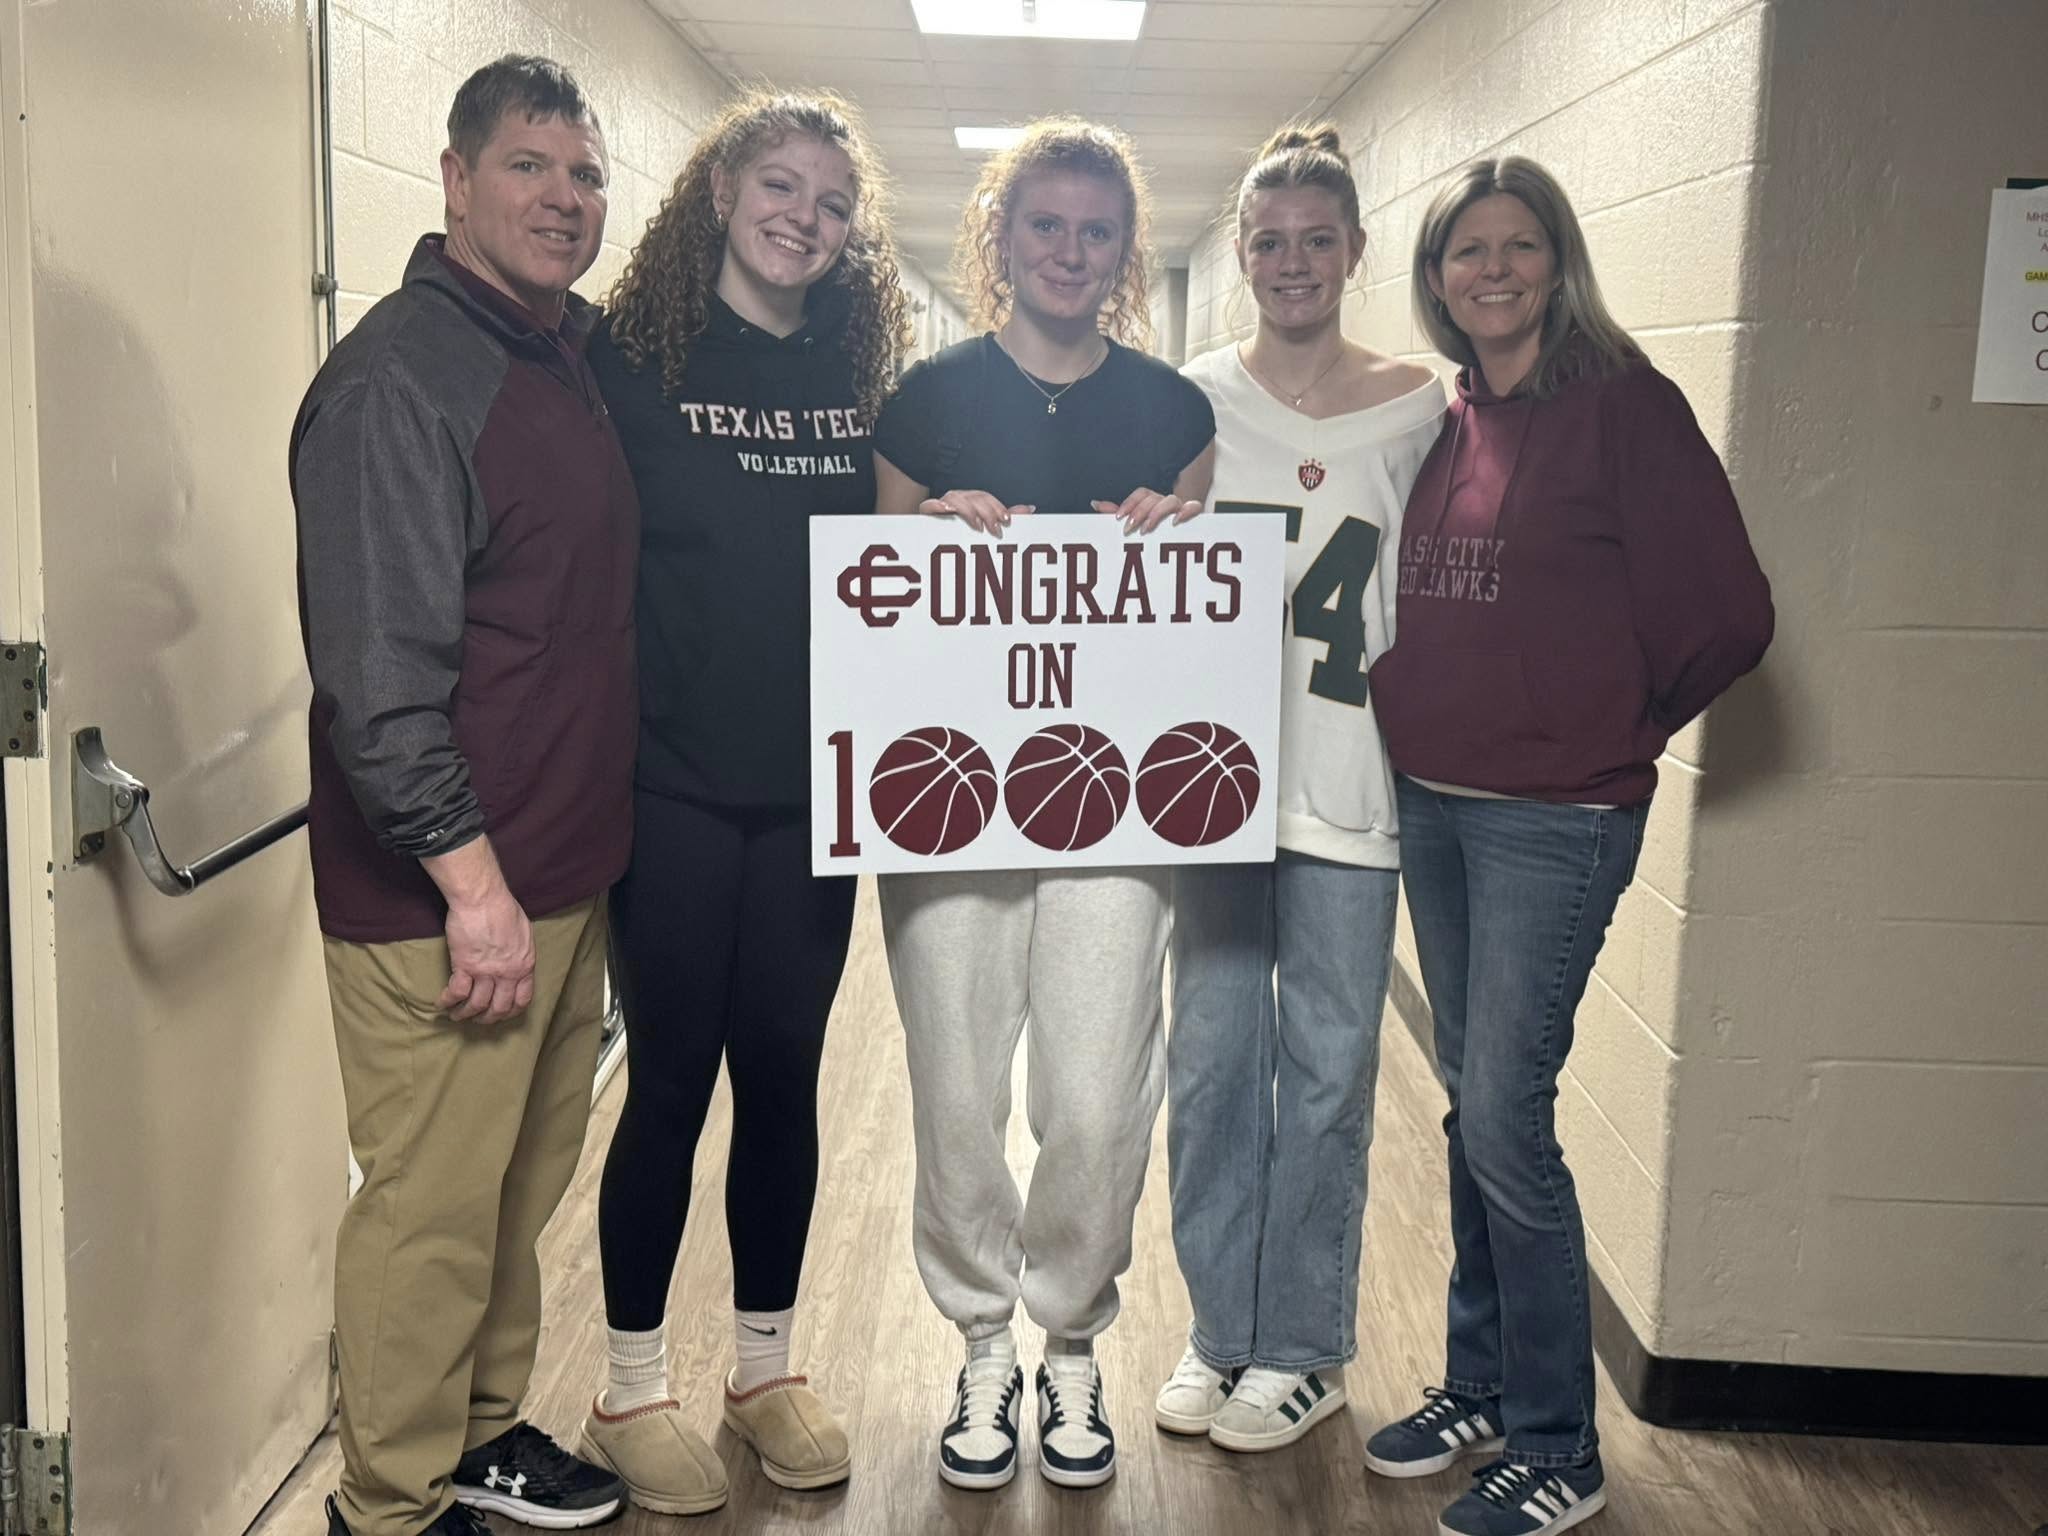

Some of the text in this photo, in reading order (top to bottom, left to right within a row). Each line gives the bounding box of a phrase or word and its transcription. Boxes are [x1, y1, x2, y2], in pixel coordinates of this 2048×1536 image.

[680, 403, 876, 440] TEXAS TEC
[1400, 535, 1505, 570] AS CITY
[1400, 566, 1418, 595] ED
[1007, 642, 1077, 709] ON
